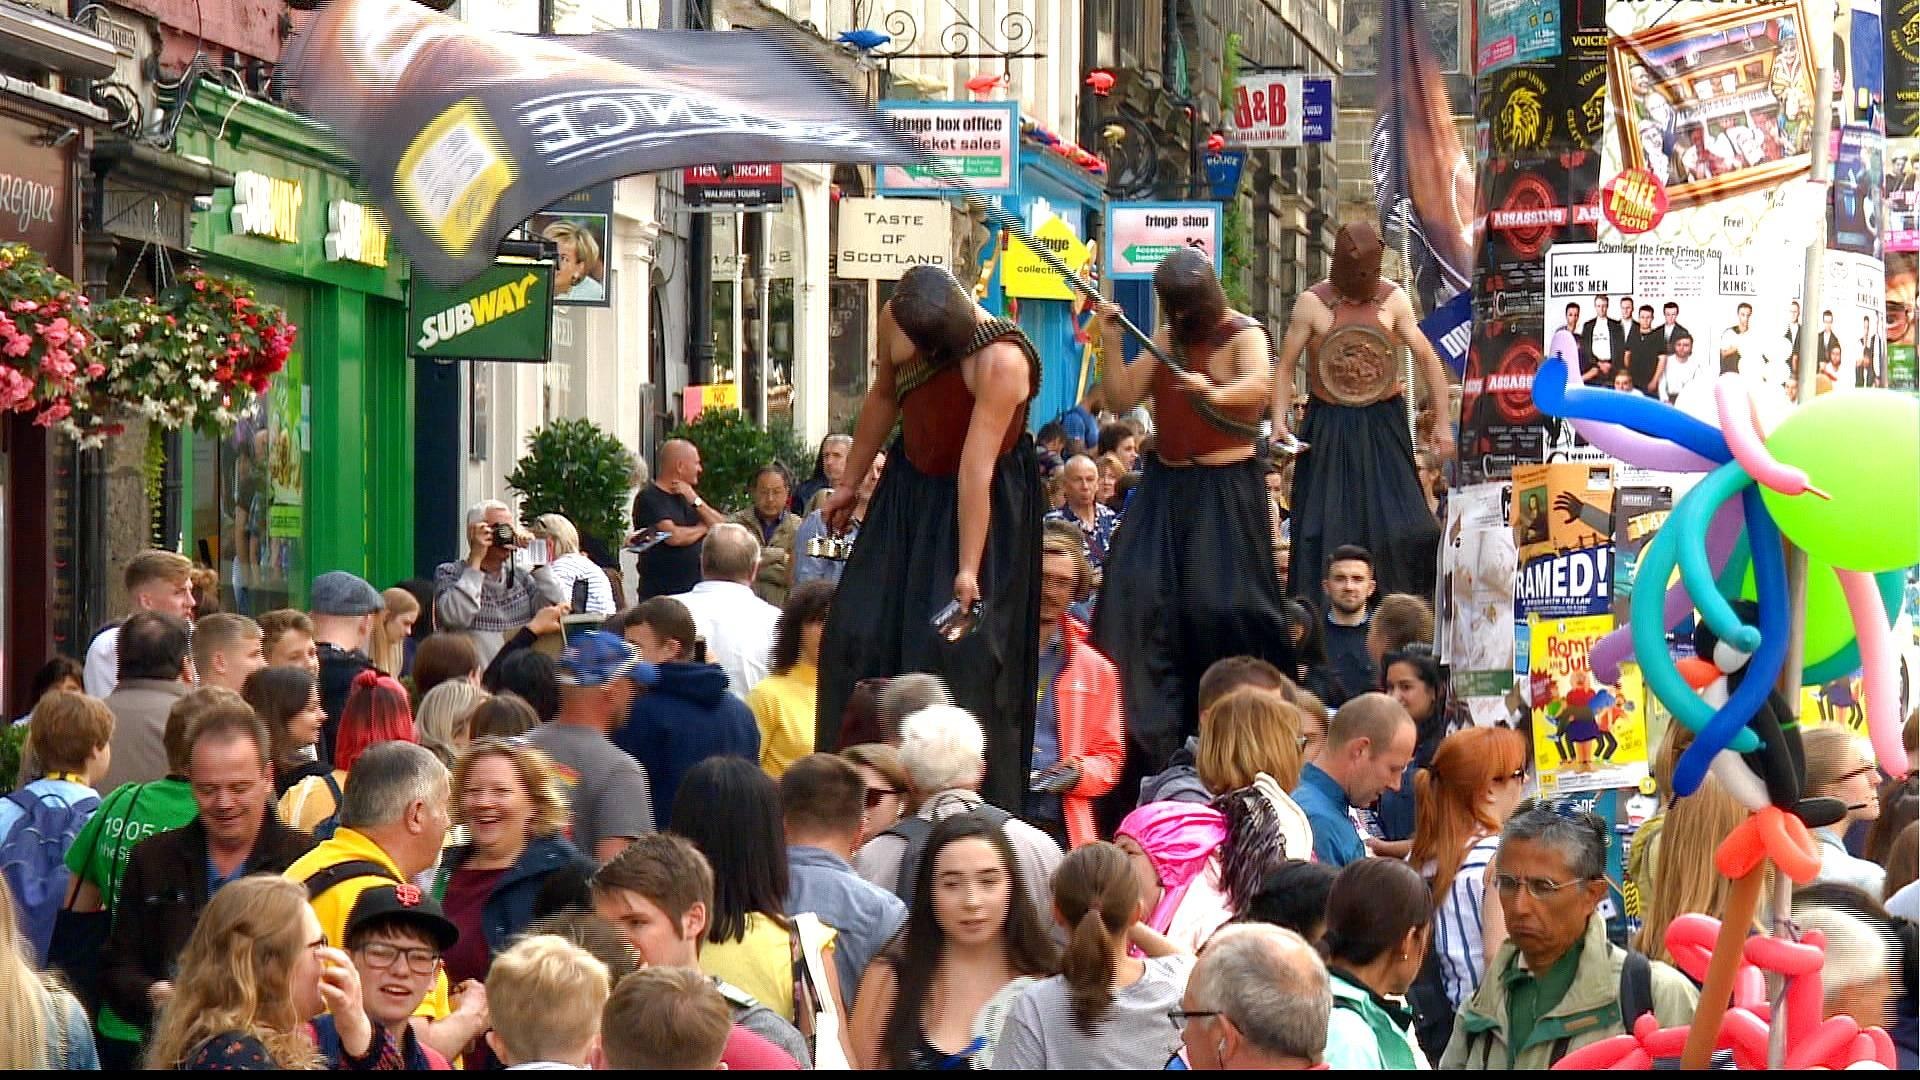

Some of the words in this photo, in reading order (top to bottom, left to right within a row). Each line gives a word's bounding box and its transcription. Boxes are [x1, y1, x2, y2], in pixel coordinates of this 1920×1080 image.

[936, 116, 960, 131] box
[963, 116, 1002, 131] office
[960, 136, 1001, 150] sales
[1207, 155, 1239, 166] POLICE
[731, 164, 772, 177] UROPE
[704, 189, 737, 199] WALKING
[738, 188, 761, 198] TOURS
[231, 170, 302, 244] SUBWAY
[864, 212, 924, 225] TASTE
[1145, 215, 1178, 229] fringe
[1182, 215, 1209, 228] shop
[1619, 213, 1649, 230] 2018
[882, 234, 906, 244] OF
[1639, 243, 1654, 255] the
[1656, 244, 1675, 255] Free
[843, 251, 943, 265] SCOTLAND
[1553, 265, 1568, 277] ALL
[1573, 264, 1590, 276] THE
[1723, 264, 1739, 276] ALL
[1553, 280, 1584, 293] KING'S
[1588, 279, 1608, 292] MEN
[417, 272, 539, 351] SUBWAY
[1489, 373, 1534, 392] ASSASS
[1516, 547, 1608, 599] RAMED!
[1560, 653, 1592, 676] JUL
